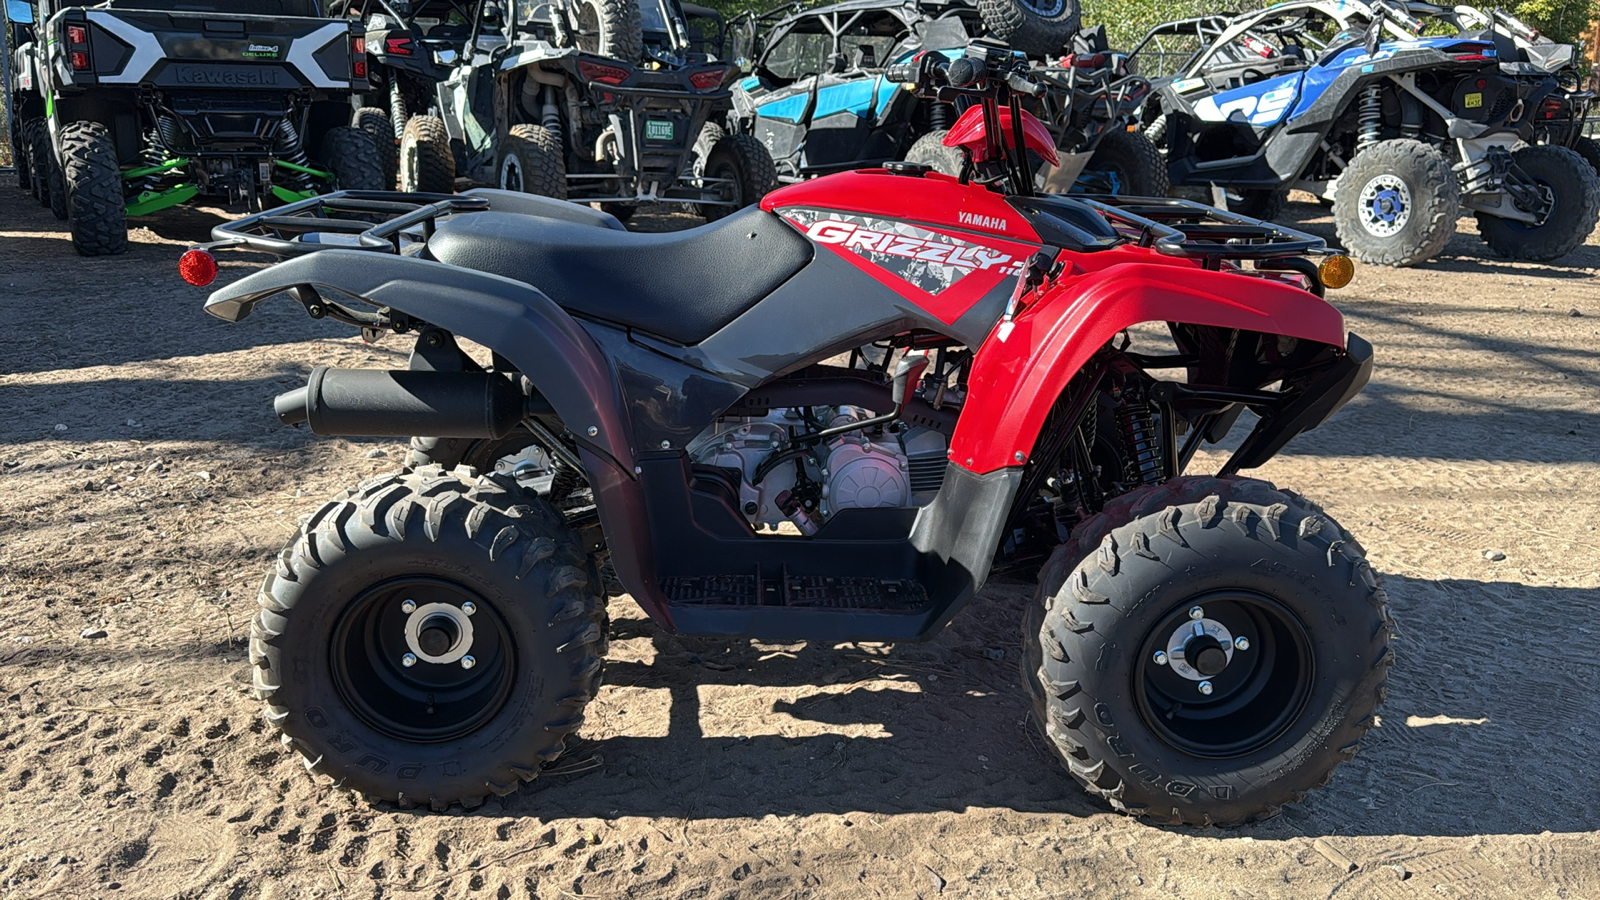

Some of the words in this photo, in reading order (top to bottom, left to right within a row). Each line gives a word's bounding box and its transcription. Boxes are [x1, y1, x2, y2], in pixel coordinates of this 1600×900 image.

[175, 65, 279, 85] Kawasaki
[806, 219, 1012, 270] GRIZZLY
[958, 211, 1006, 231] YAMAHA
[304, 706, 426, 781] DURO
[1093, 702, 1198, 798] DURO
